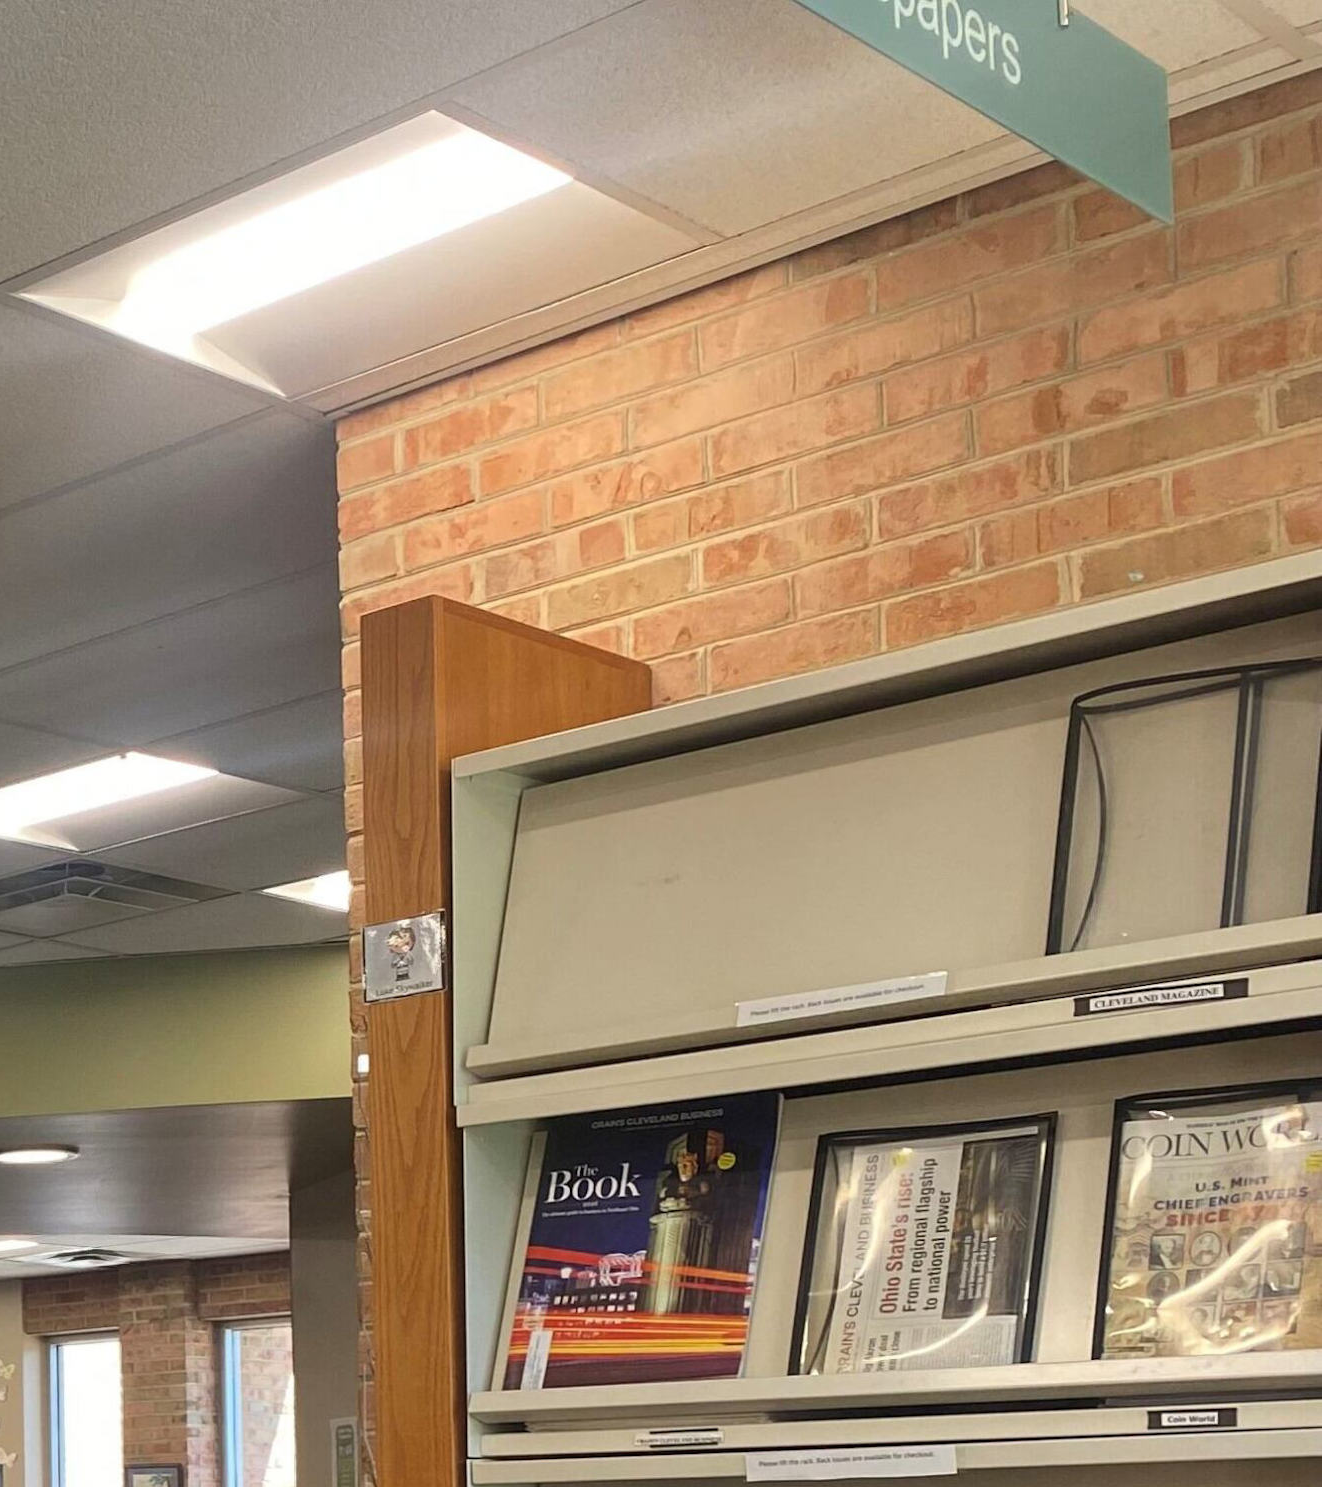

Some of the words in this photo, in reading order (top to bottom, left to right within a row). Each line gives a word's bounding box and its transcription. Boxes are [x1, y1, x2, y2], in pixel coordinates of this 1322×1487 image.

[878, 0, 1021, 85] papers
[1094, 993, 1158, 1009] CLEVELAND
[1160, 986, 1219, 1000] MAGAZINE
[1122, 1131, 1212, 1160] COIN
[544, 1162, 642, 1204] Book
[574, 1163, 599, 1177] The
[918, 1158, 939, 1214] flagship
[1195, 1180, 1225, 1192] U.S.
[899, 1172, 915, 1209] rise:
[1153, 1198, 1206, 1211] CHIEF
[1209, 1186, 1309, 1208] ENGRAVERS
[936, 1190, 952, 1235] power
[887, 1215, 909, 1272] State's
[911, 1217, 930, 1272] regional
[848, 1229, 870, 1319] CLEVAND
[928, 1238, 946, 1295] national
[879, 1277, 901, 1314] Ohio
[903, 1274, 921, 1312] From
[923, 1300, 937, 1310] to
[1167, 1416, 1187, 1424] Coin
[1189, 1414, 1216, 1422] World
